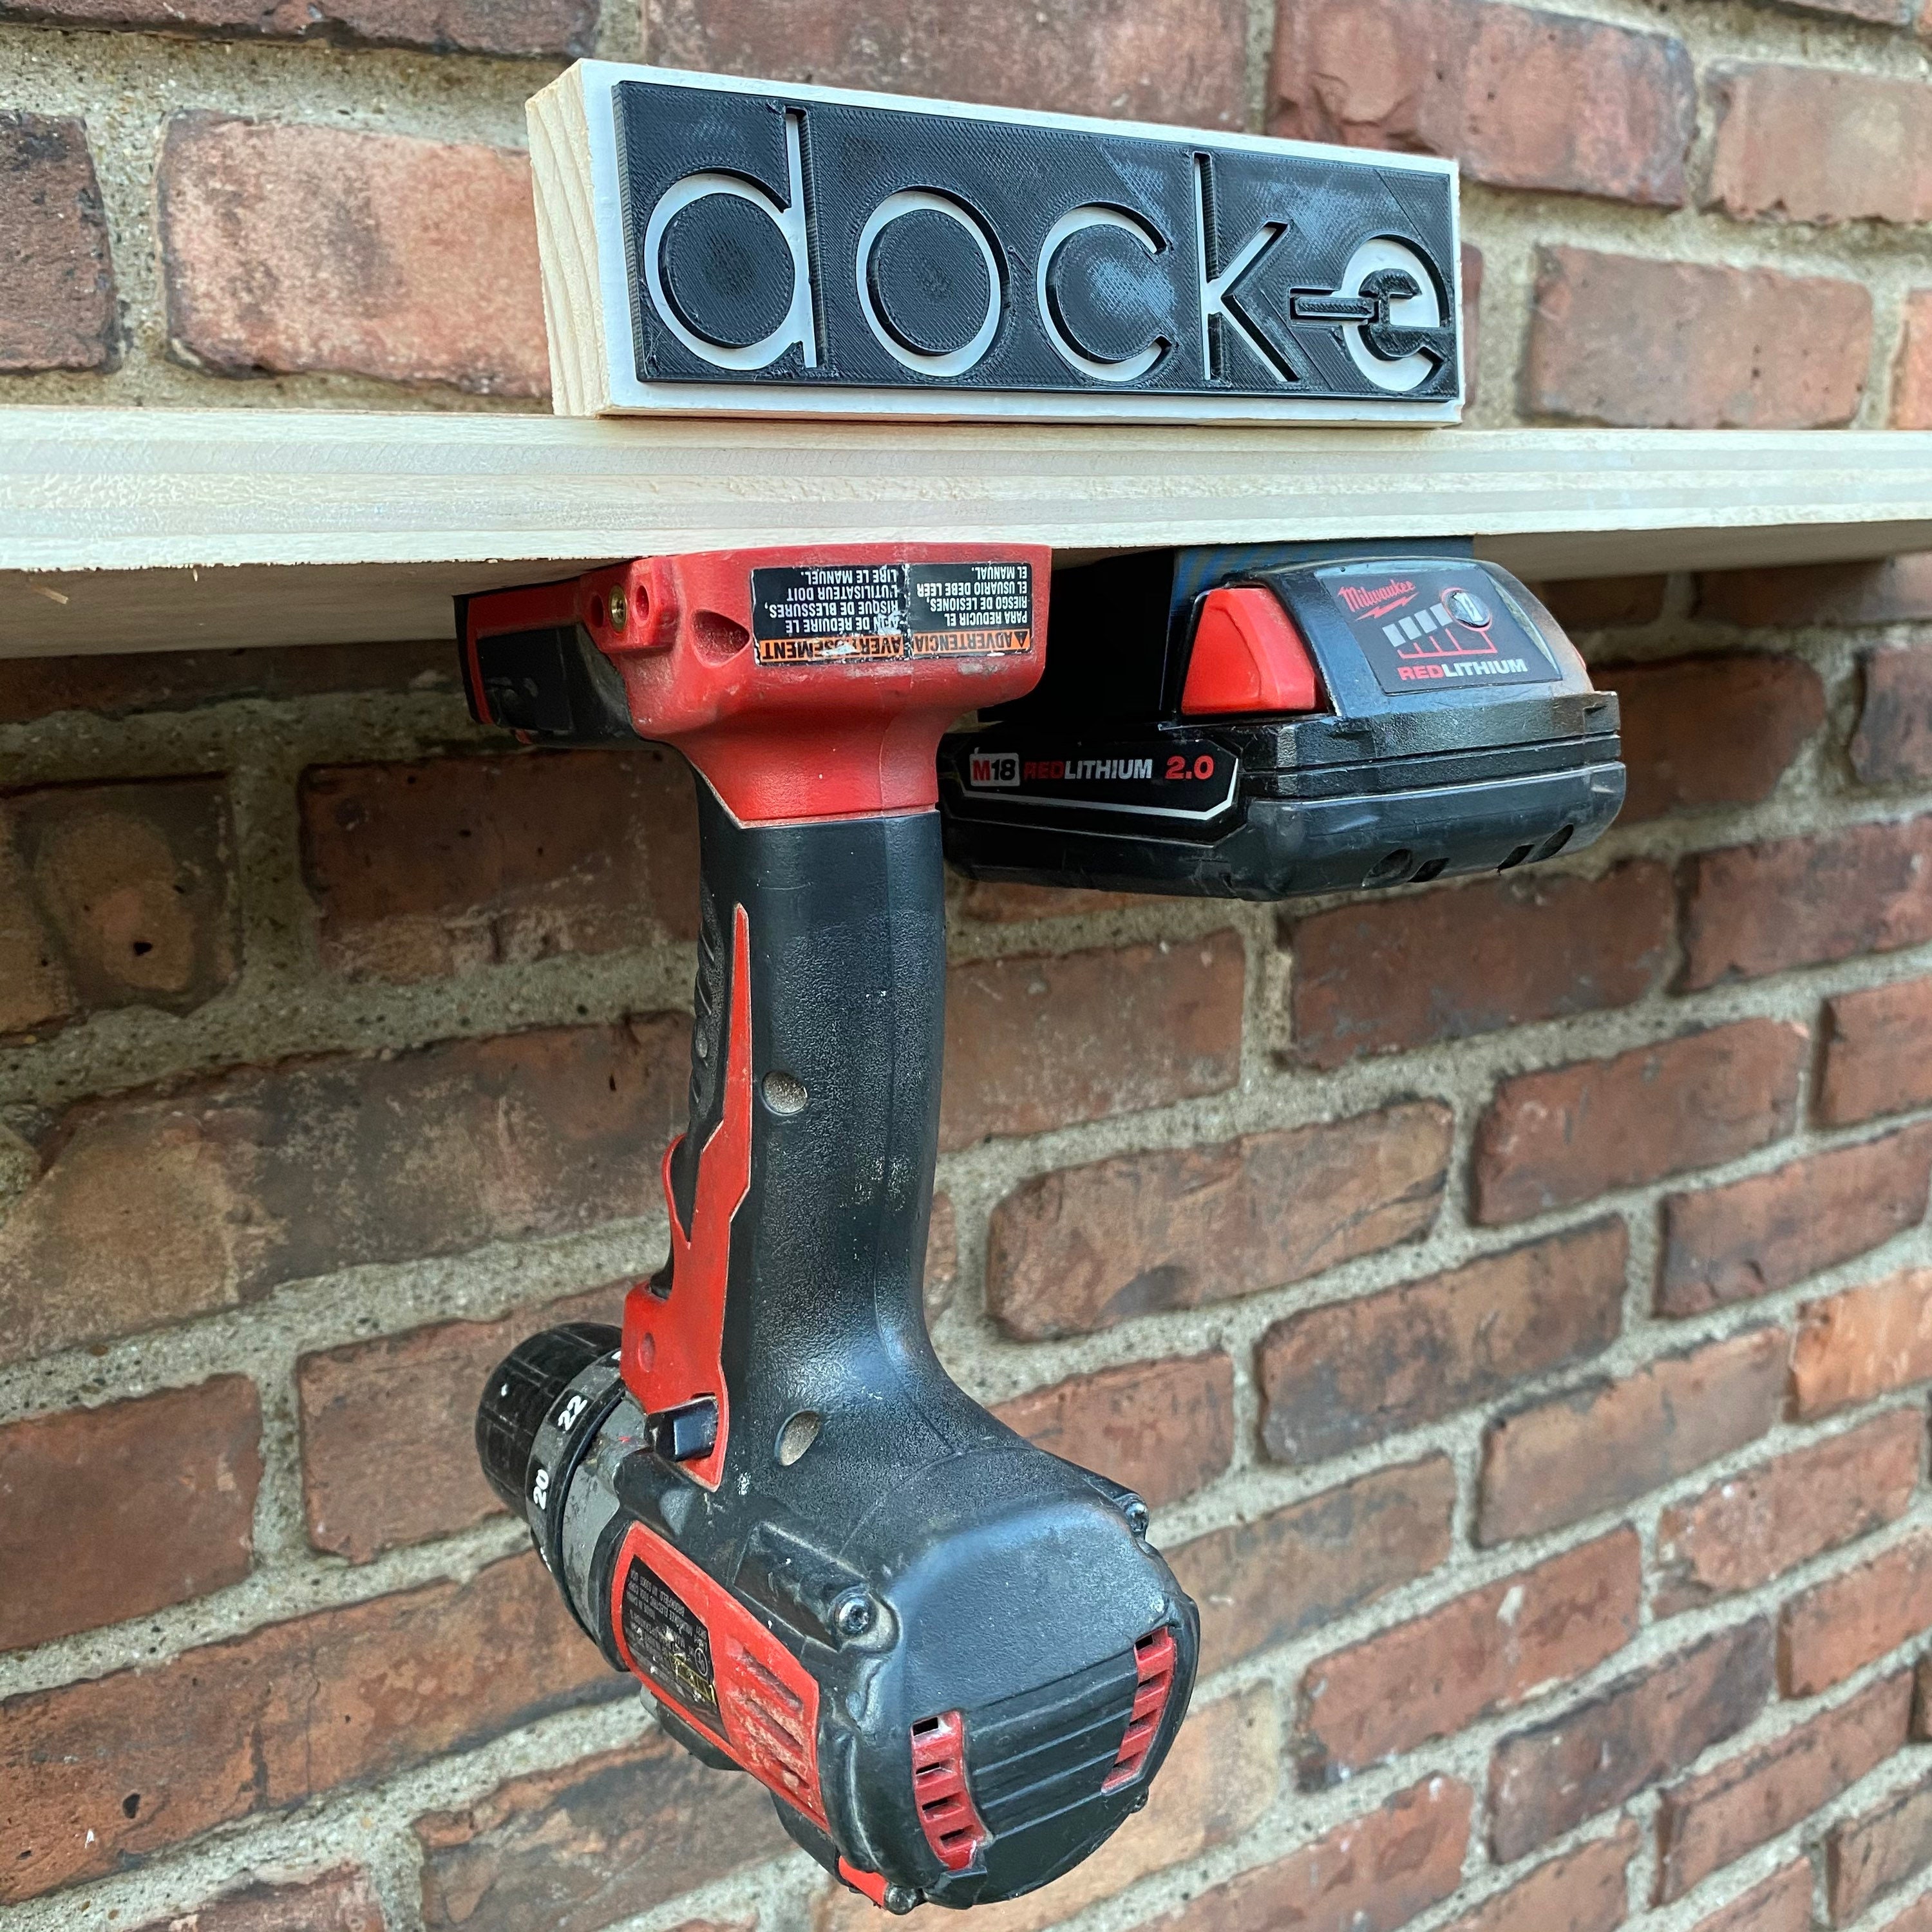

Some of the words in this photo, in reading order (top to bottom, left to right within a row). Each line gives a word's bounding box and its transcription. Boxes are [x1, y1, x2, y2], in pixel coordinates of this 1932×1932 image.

[644, 104, 1451, 392] dock-e
[800, 570, 853, 585] MANUEL.
[857, 570, 869, 583] LE
[873, 569, 896, 582] LIRE
[971, 566, 1015, 580] MANUAL.
[1018, 566, 1027, 579] EL
[786, 587, 815, 601] DOIT
[817, 585, 898, 600] L'UTILISATEUR
[917, 583, 942, 597] LEER
[945, 582, 971, 596] DEBE
[974, 582, 1015, 595] USUARIO
[1018, 581, 1027, 594] EL
[996, 596, 1027, 609] RIESGO
[1338, 579, 1416, 612] Milwaukee
[764, 602, 837, 618] BLESSURES,
[840, 601, 856, 616] DE
[858, 600, 898, 614] RISQUE
[927, 597, 978, 612] LESIONES,
[980, 597, 993, 610] DE
[855, 617, 869, 630] DE
[944, 613, 956, 627] EL
[960, 612, 1002, 626] REDUCIR
[1005, 611, 1027, 624] PARA
[785, 619, 800, 634] LE
[804, 618, 853, 634] RÉDUIRE
[914, 632, 1013, 652] ADVERTENCIA
[1396, 658, 1528, 680] REDLITHIUM
[972, 759, 1016, 781] M18
[1023, 758, 1153, 781] REDLITHIUM
[1165, 755, 1215, 781] 2.0
[558, 1395, 587, 1432] 22
[533, 1468, 549, 1510] 20
